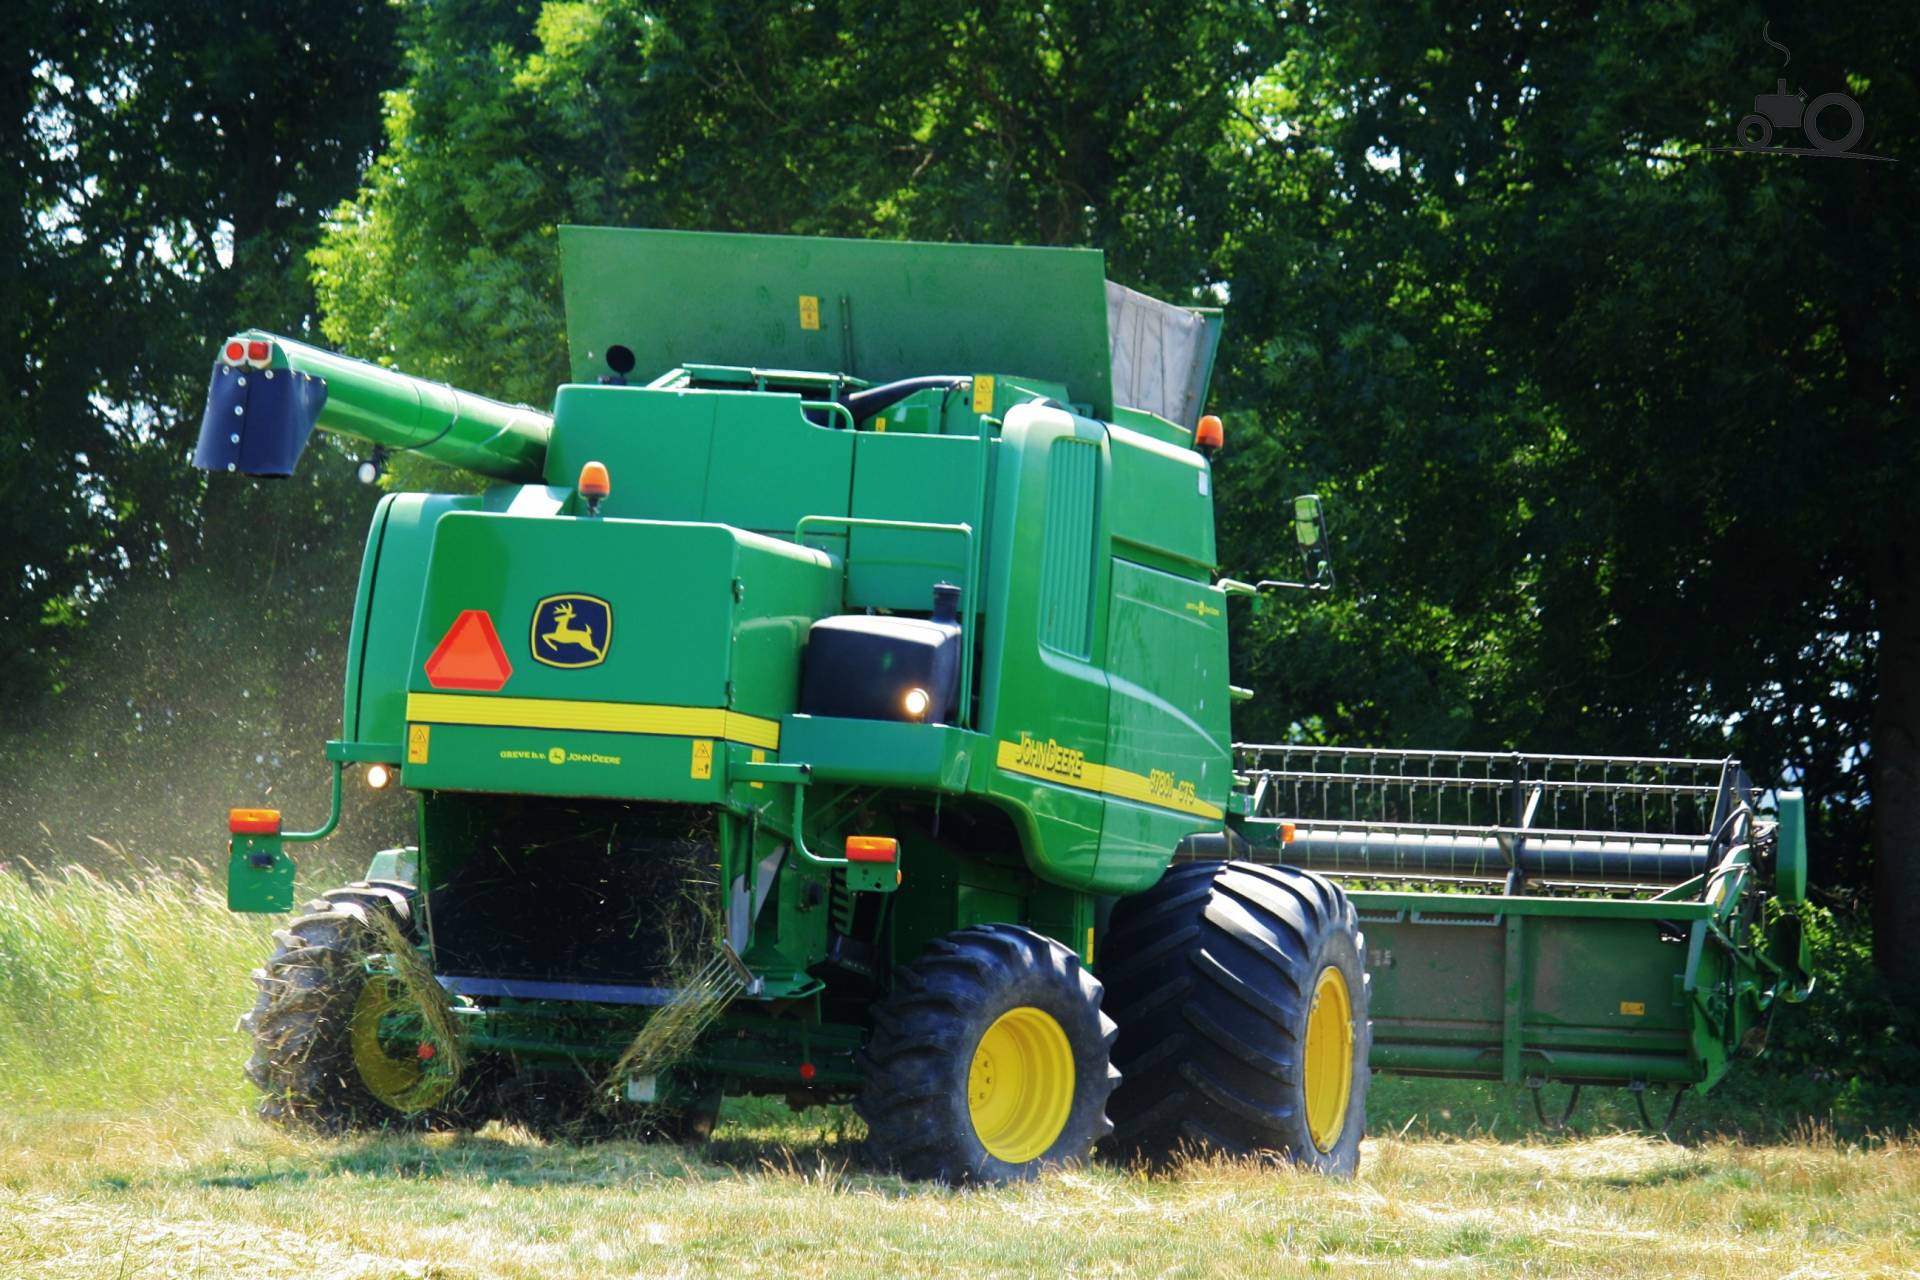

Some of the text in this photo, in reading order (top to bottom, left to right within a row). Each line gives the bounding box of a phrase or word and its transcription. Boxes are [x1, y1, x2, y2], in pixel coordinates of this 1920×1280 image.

[500, 750, 530, 759] GREVE
[567, 753, 592, 762] JOHN
[592, 754, 621, 765] DEERE
[1016, 731, 1085, 779] JOHN DEERE
